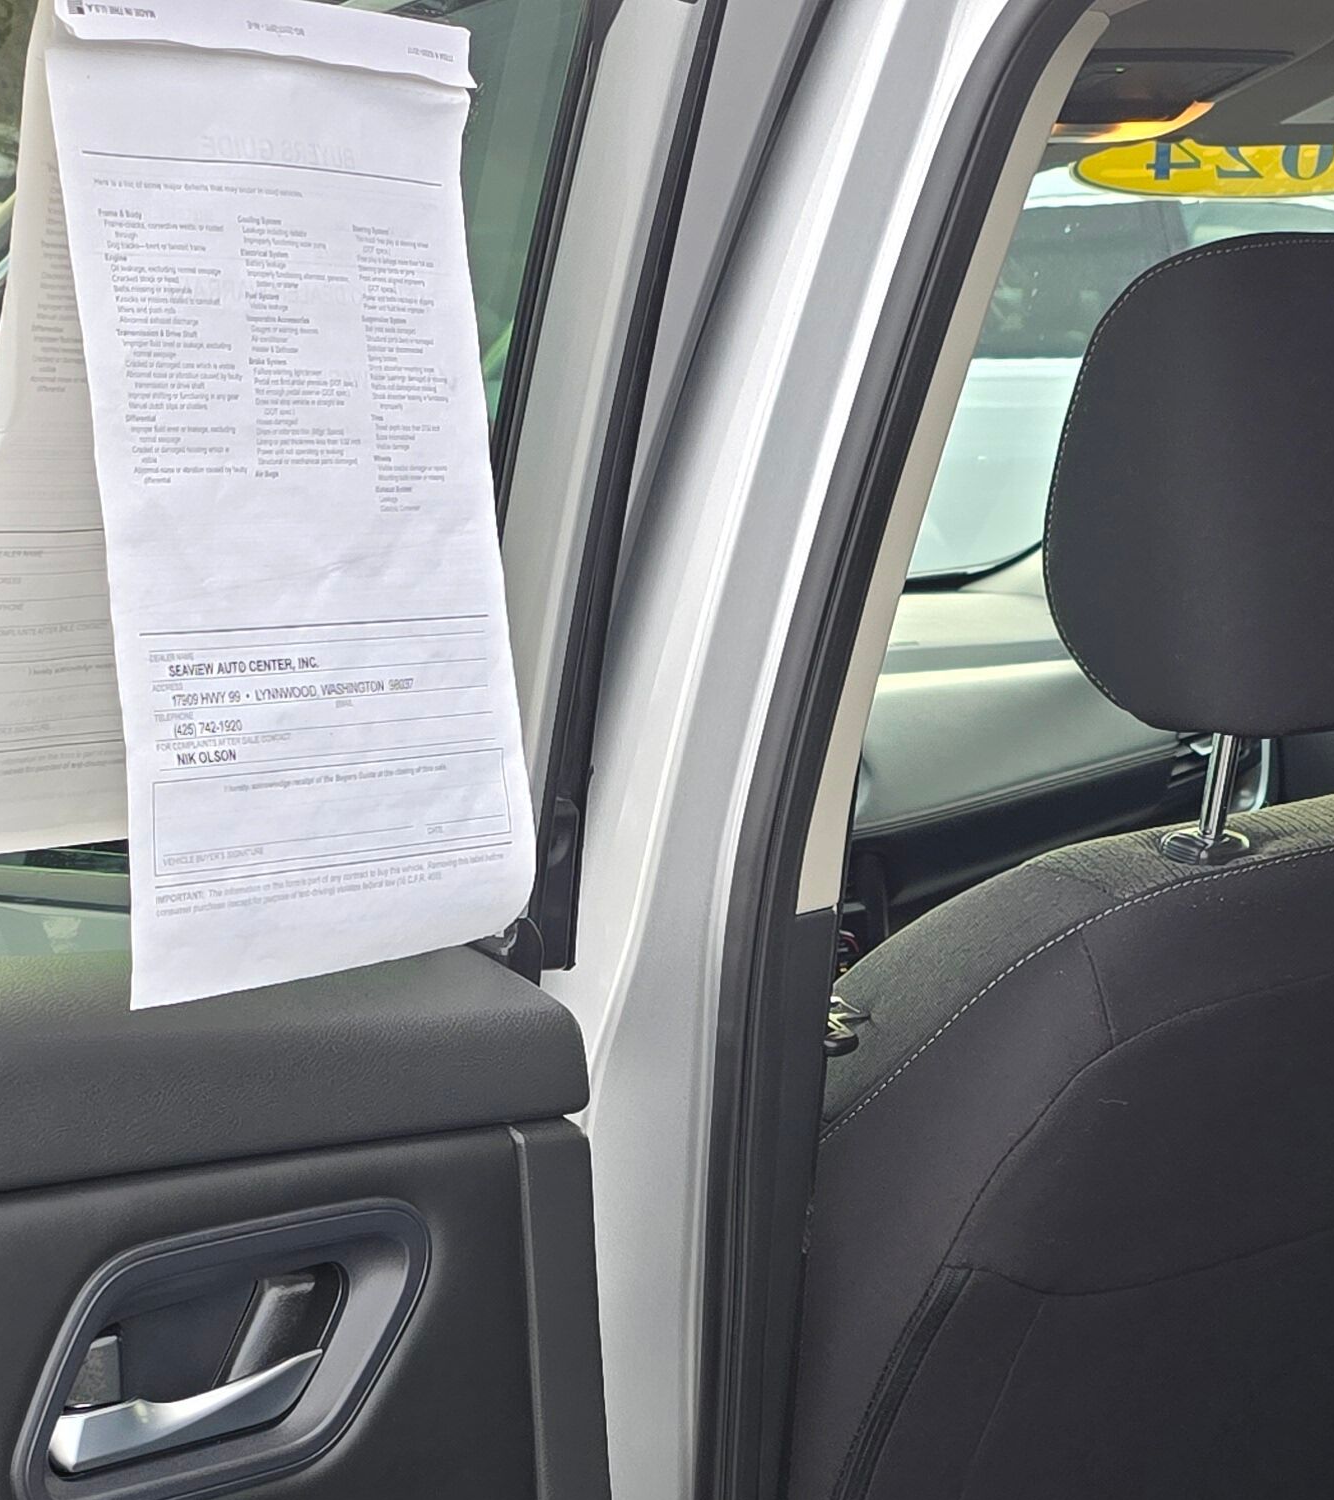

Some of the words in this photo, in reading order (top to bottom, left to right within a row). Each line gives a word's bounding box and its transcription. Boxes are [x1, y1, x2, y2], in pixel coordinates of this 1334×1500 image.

[169, 663, 213, 677] SEAVIEW
[217, 661, 246, 674] AUTO
[249, 659, 295, 675] CENTER,
[298, 657, 319, 672] INC.
[200, 692, 226, 704] HWY
[228, 690, 241, 703] 99
[320, 681, 384, 695] WASHINGTON
[177, 753, 196, 765] NIK
[199, 750, 236, 764] OLSON
